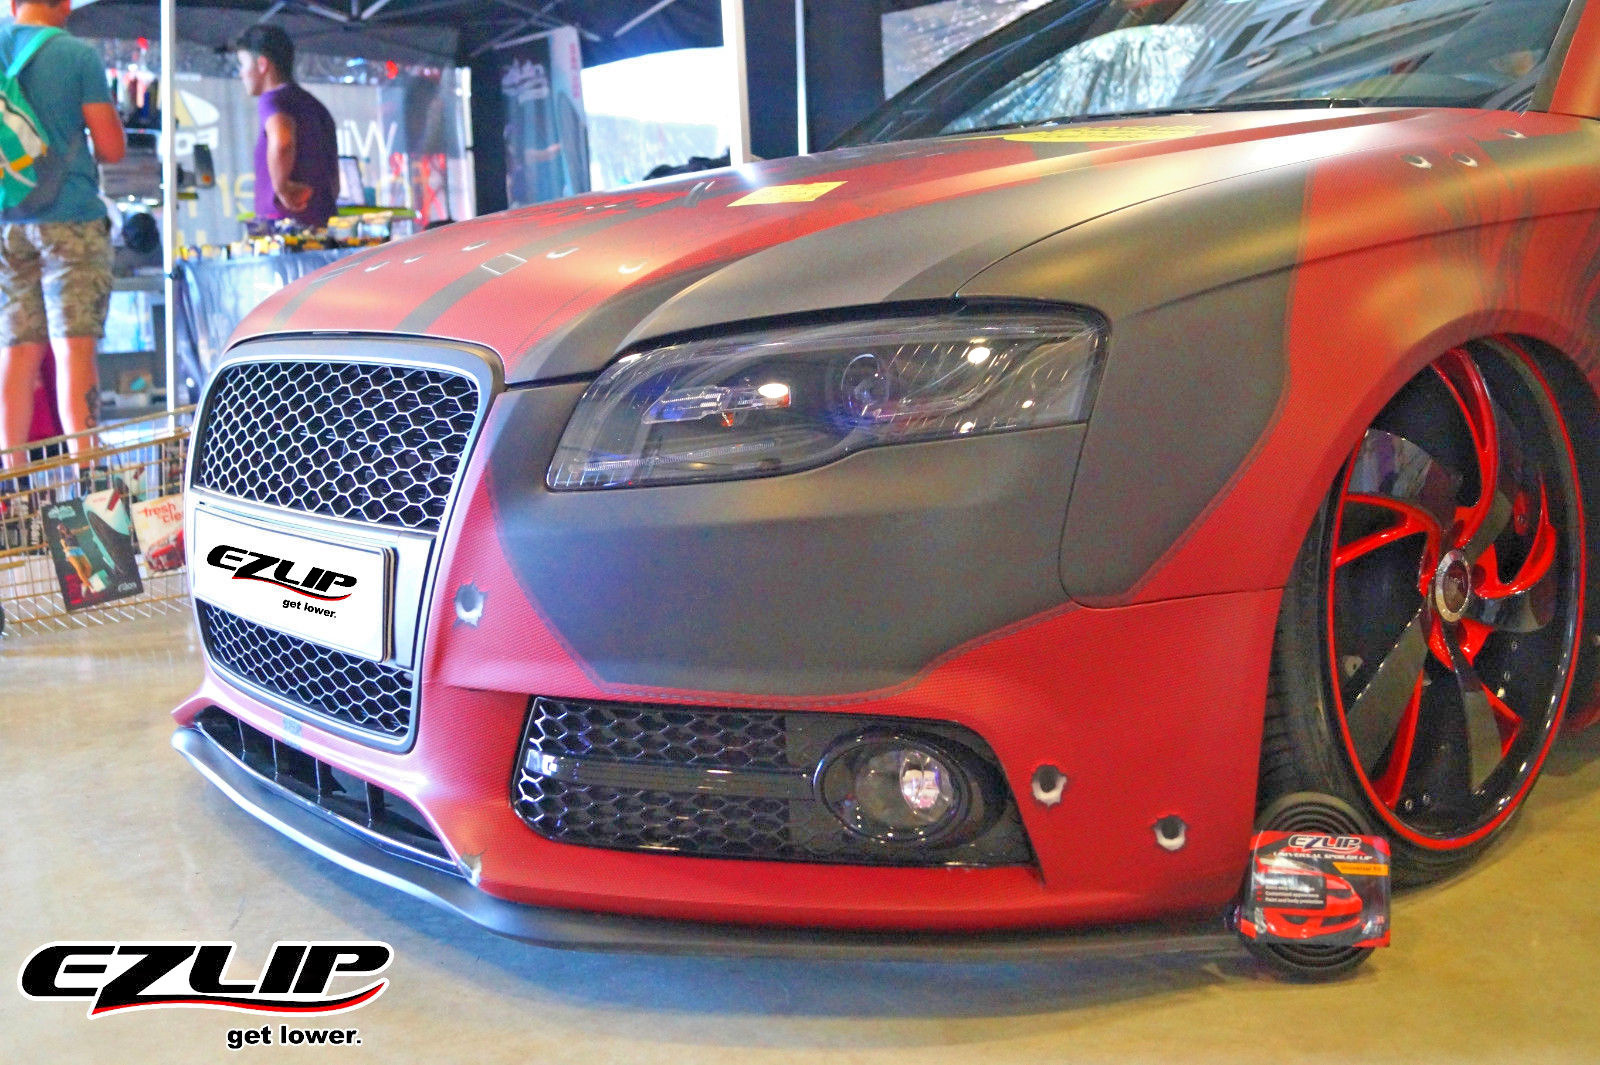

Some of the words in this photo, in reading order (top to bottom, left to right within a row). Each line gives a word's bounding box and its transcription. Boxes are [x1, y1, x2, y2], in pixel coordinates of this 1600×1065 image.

[206, 544, 358, 596] EZLIP
[283, 599, 301, 610] get
[304, 602, 337, 618] lower.
[1289, 834, 1362, 851] EZLIP
